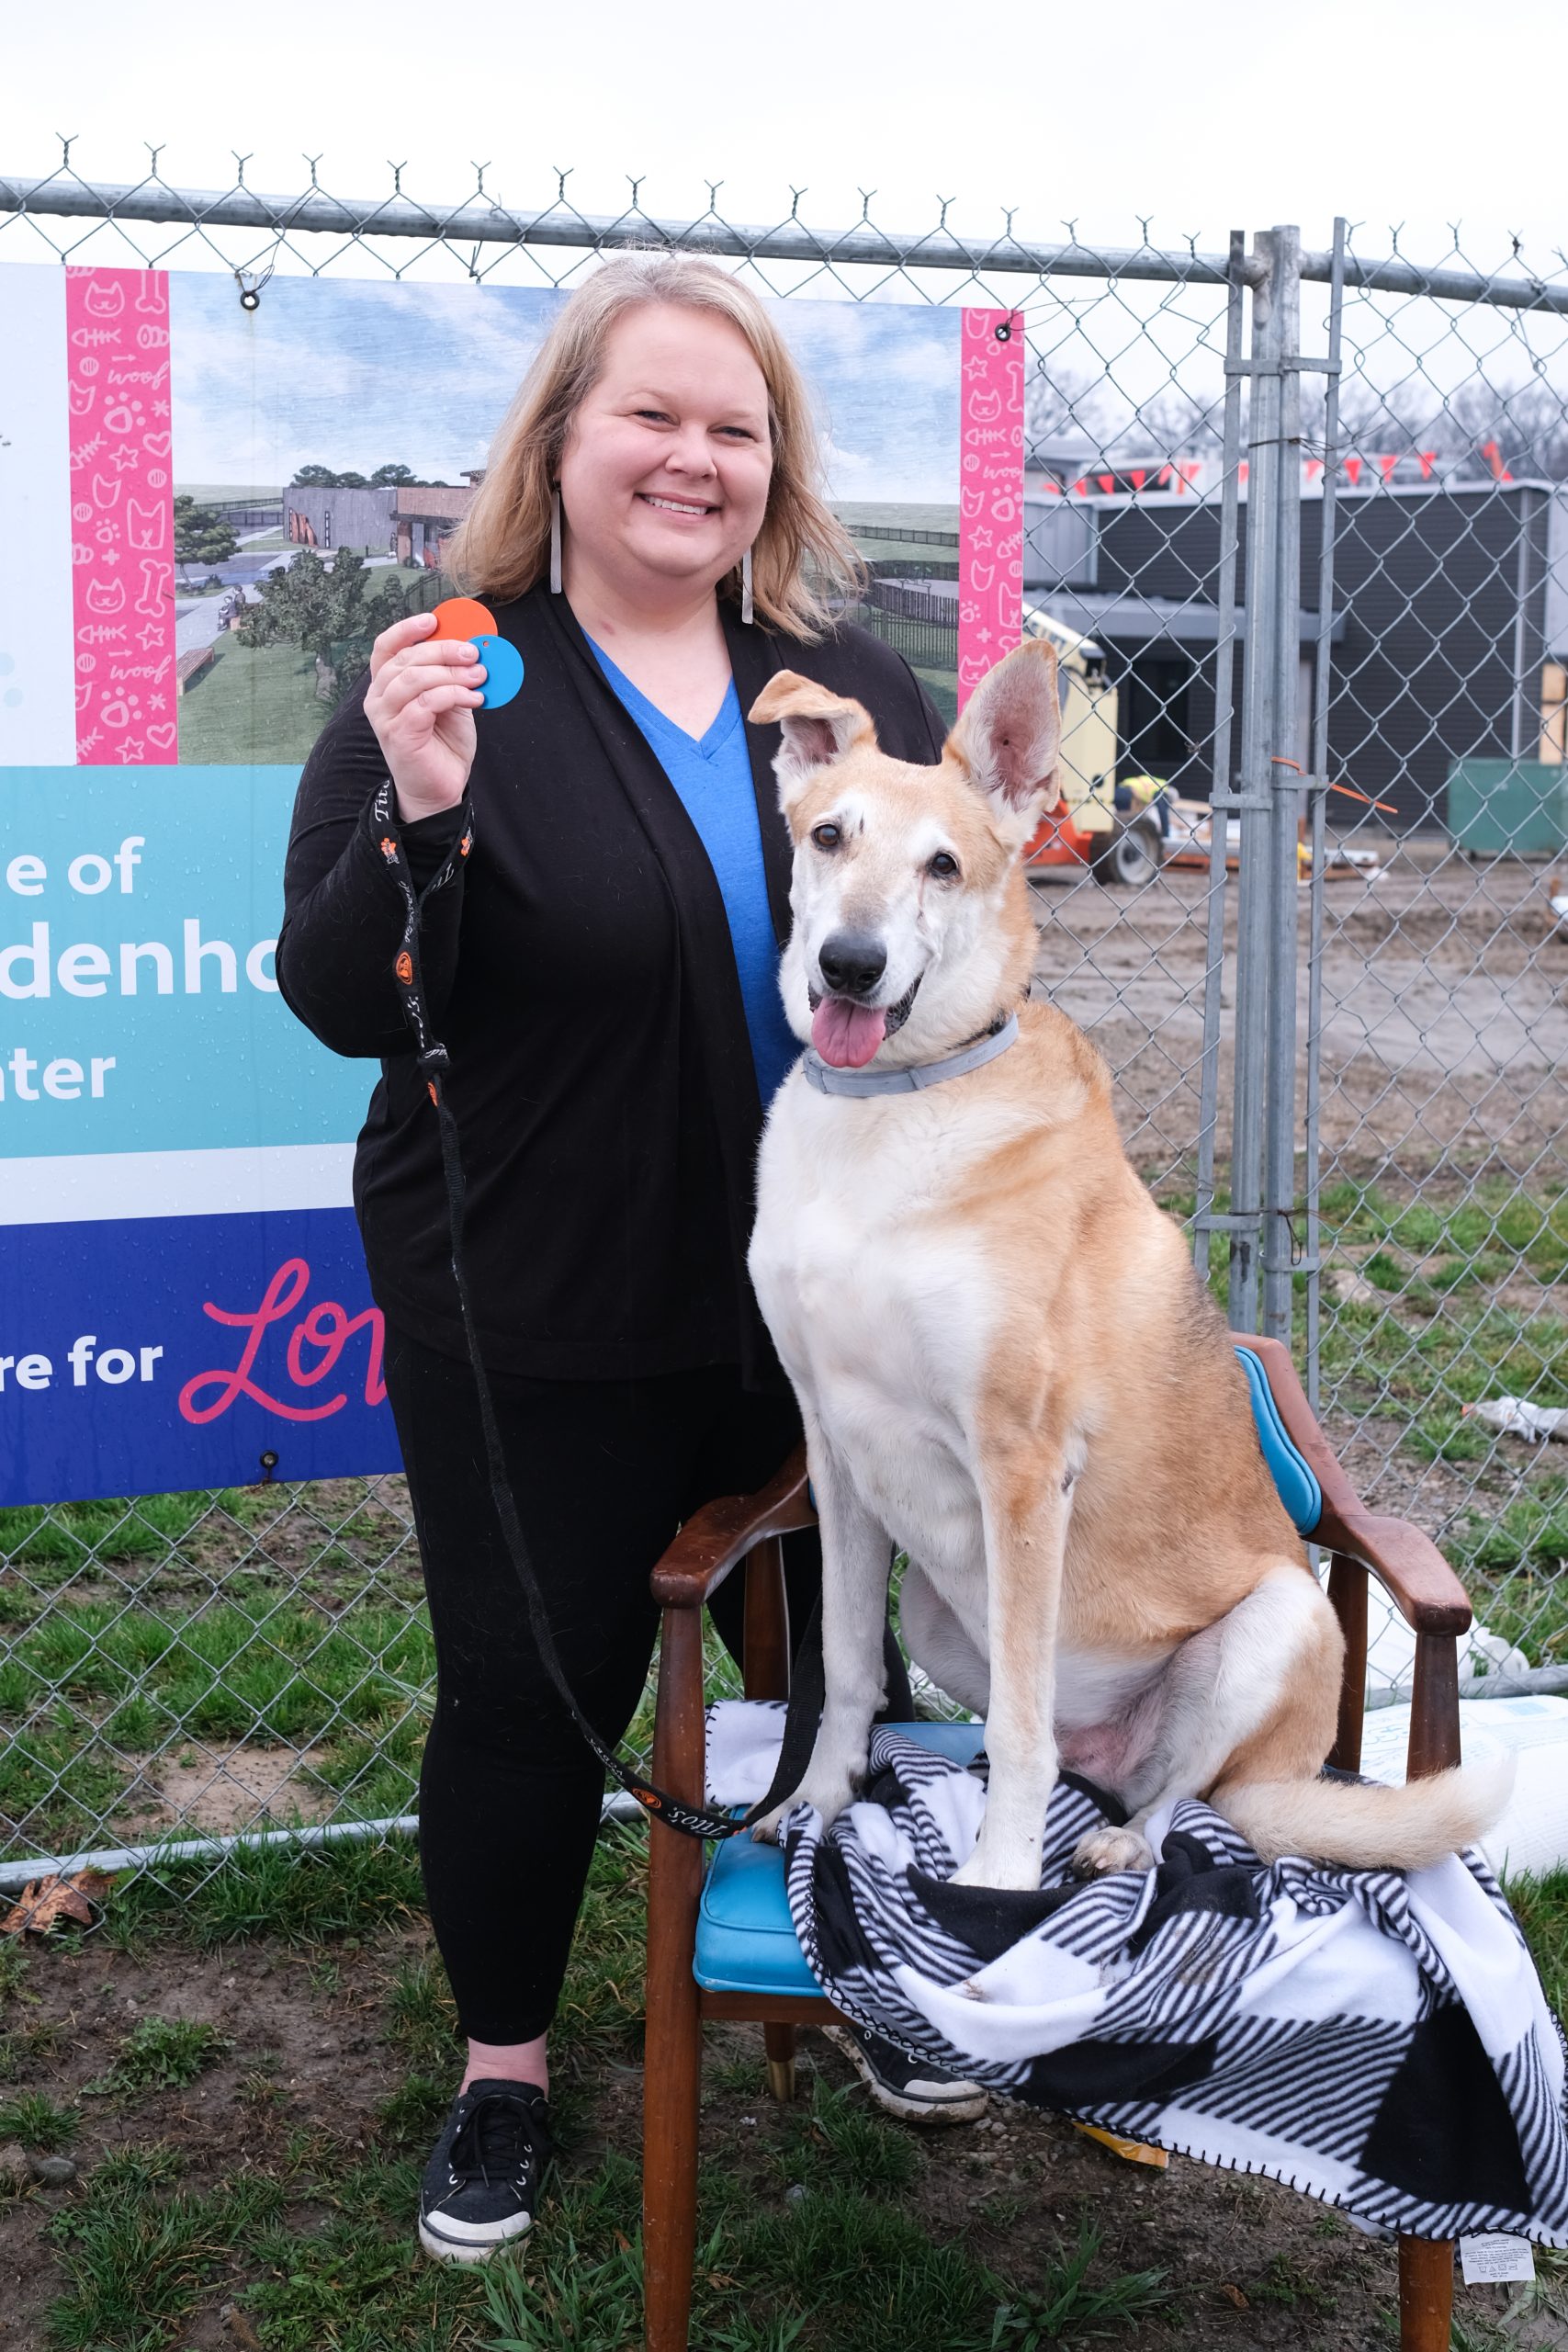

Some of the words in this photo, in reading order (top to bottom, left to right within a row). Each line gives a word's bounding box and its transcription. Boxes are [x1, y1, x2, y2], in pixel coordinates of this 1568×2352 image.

[108, 360, 169, 390] woof
[983, 465, 1024, 484] woo
[111, 655, 172, 684] woof
[68, 836, 145, 895] of
[0, 1048, 116, 1102] ter
[67, 1335, 164, 1386] for
